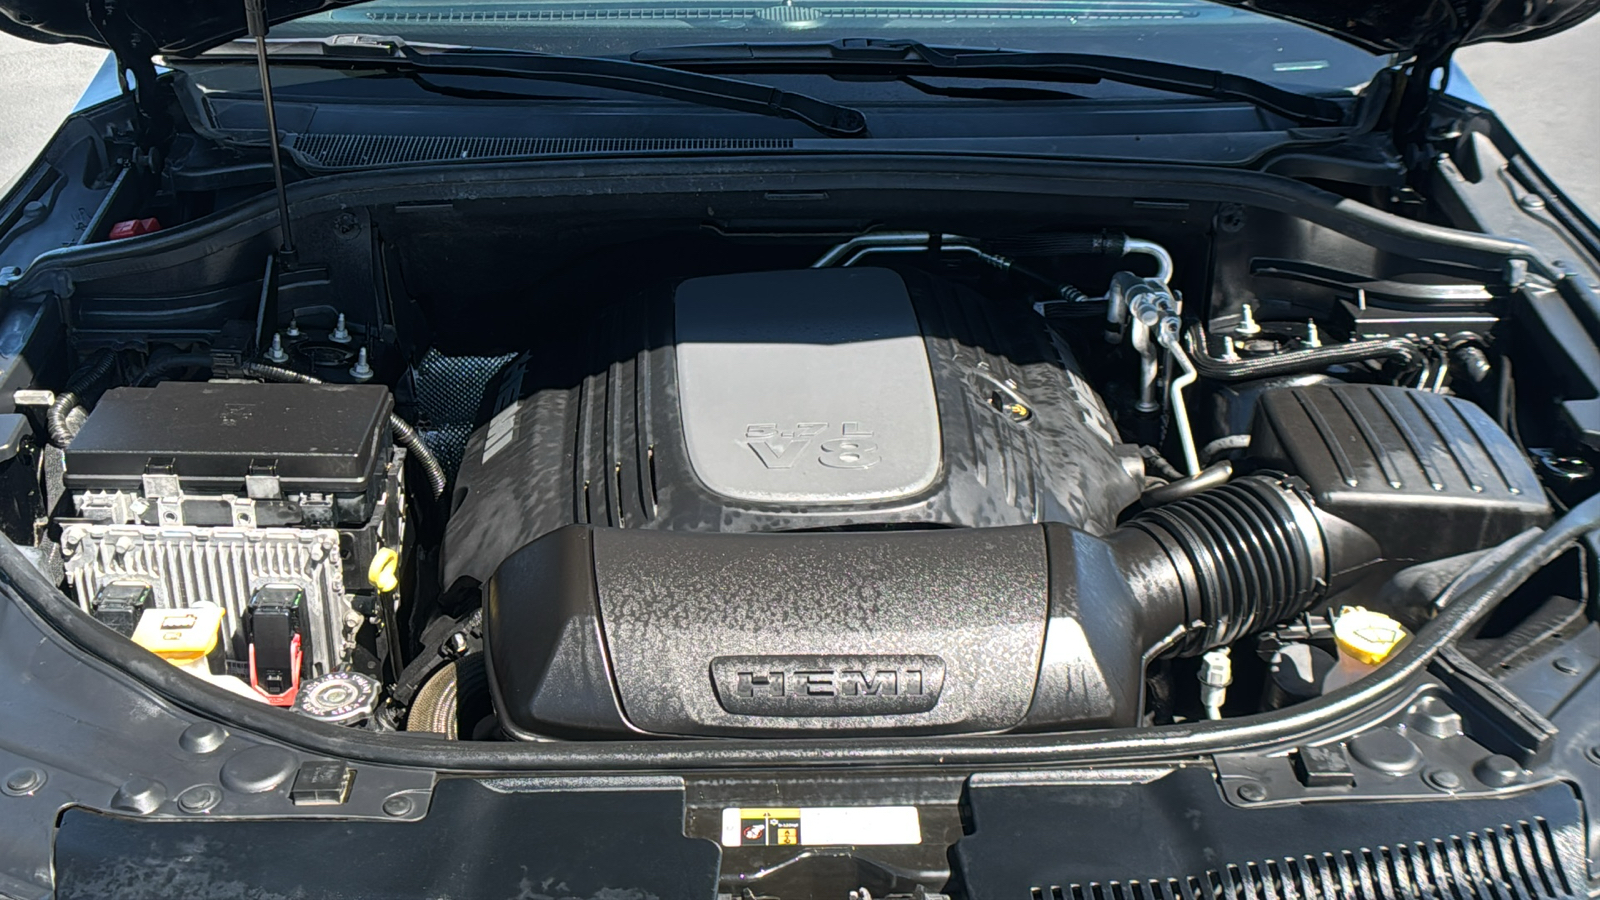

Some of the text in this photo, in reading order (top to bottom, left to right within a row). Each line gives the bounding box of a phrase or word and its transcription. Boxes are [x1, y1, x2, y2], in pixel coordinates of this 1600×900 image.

[745, 421, 874, 438] 5.7L
[747, 437, 882, 470] V8
[737, 669, 923, 698] HEMI
